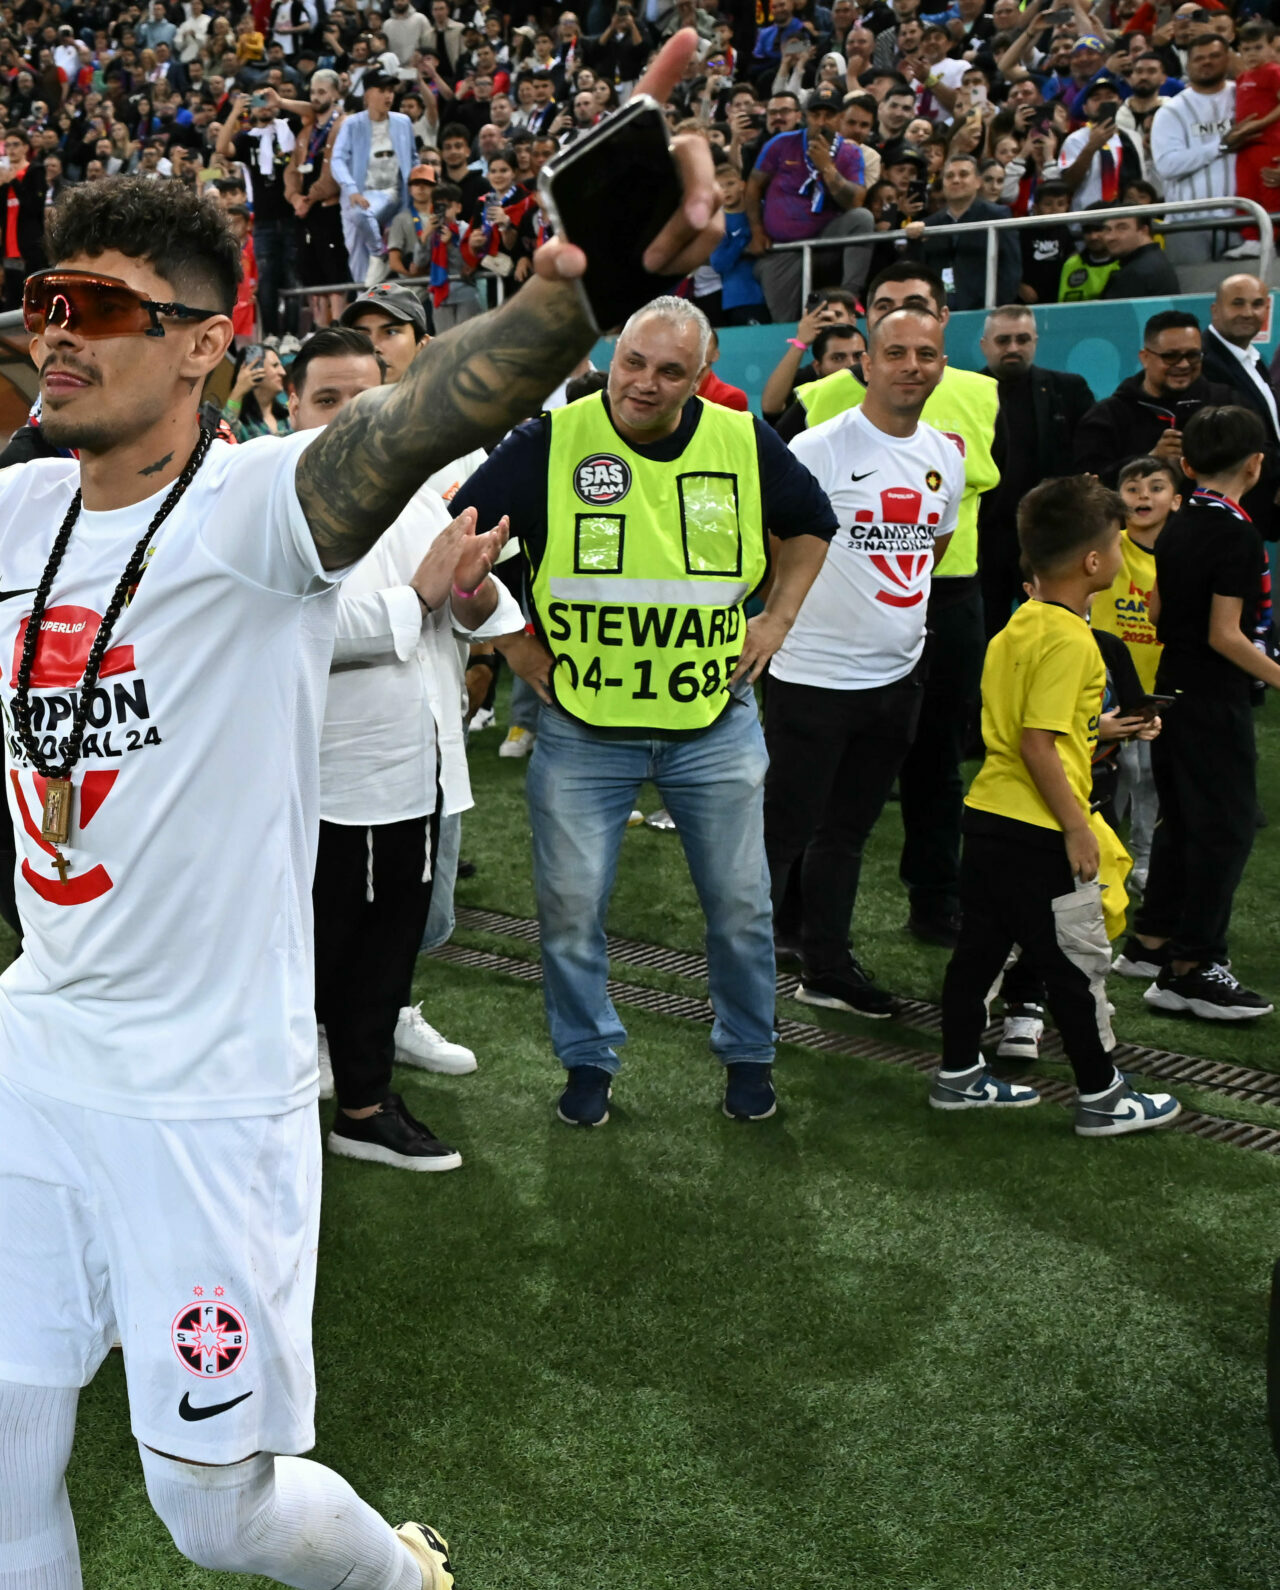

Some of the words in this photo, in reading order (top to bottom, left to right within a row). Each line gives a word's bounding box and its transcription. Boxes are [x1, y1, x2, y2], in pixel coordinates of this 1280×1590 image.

[580, 464, 623, 487] SAS
[581, 483, 624, 496] TEAM
[548, 602, 740, 648] STEWARD
[126, 726, 162, 752] 24
